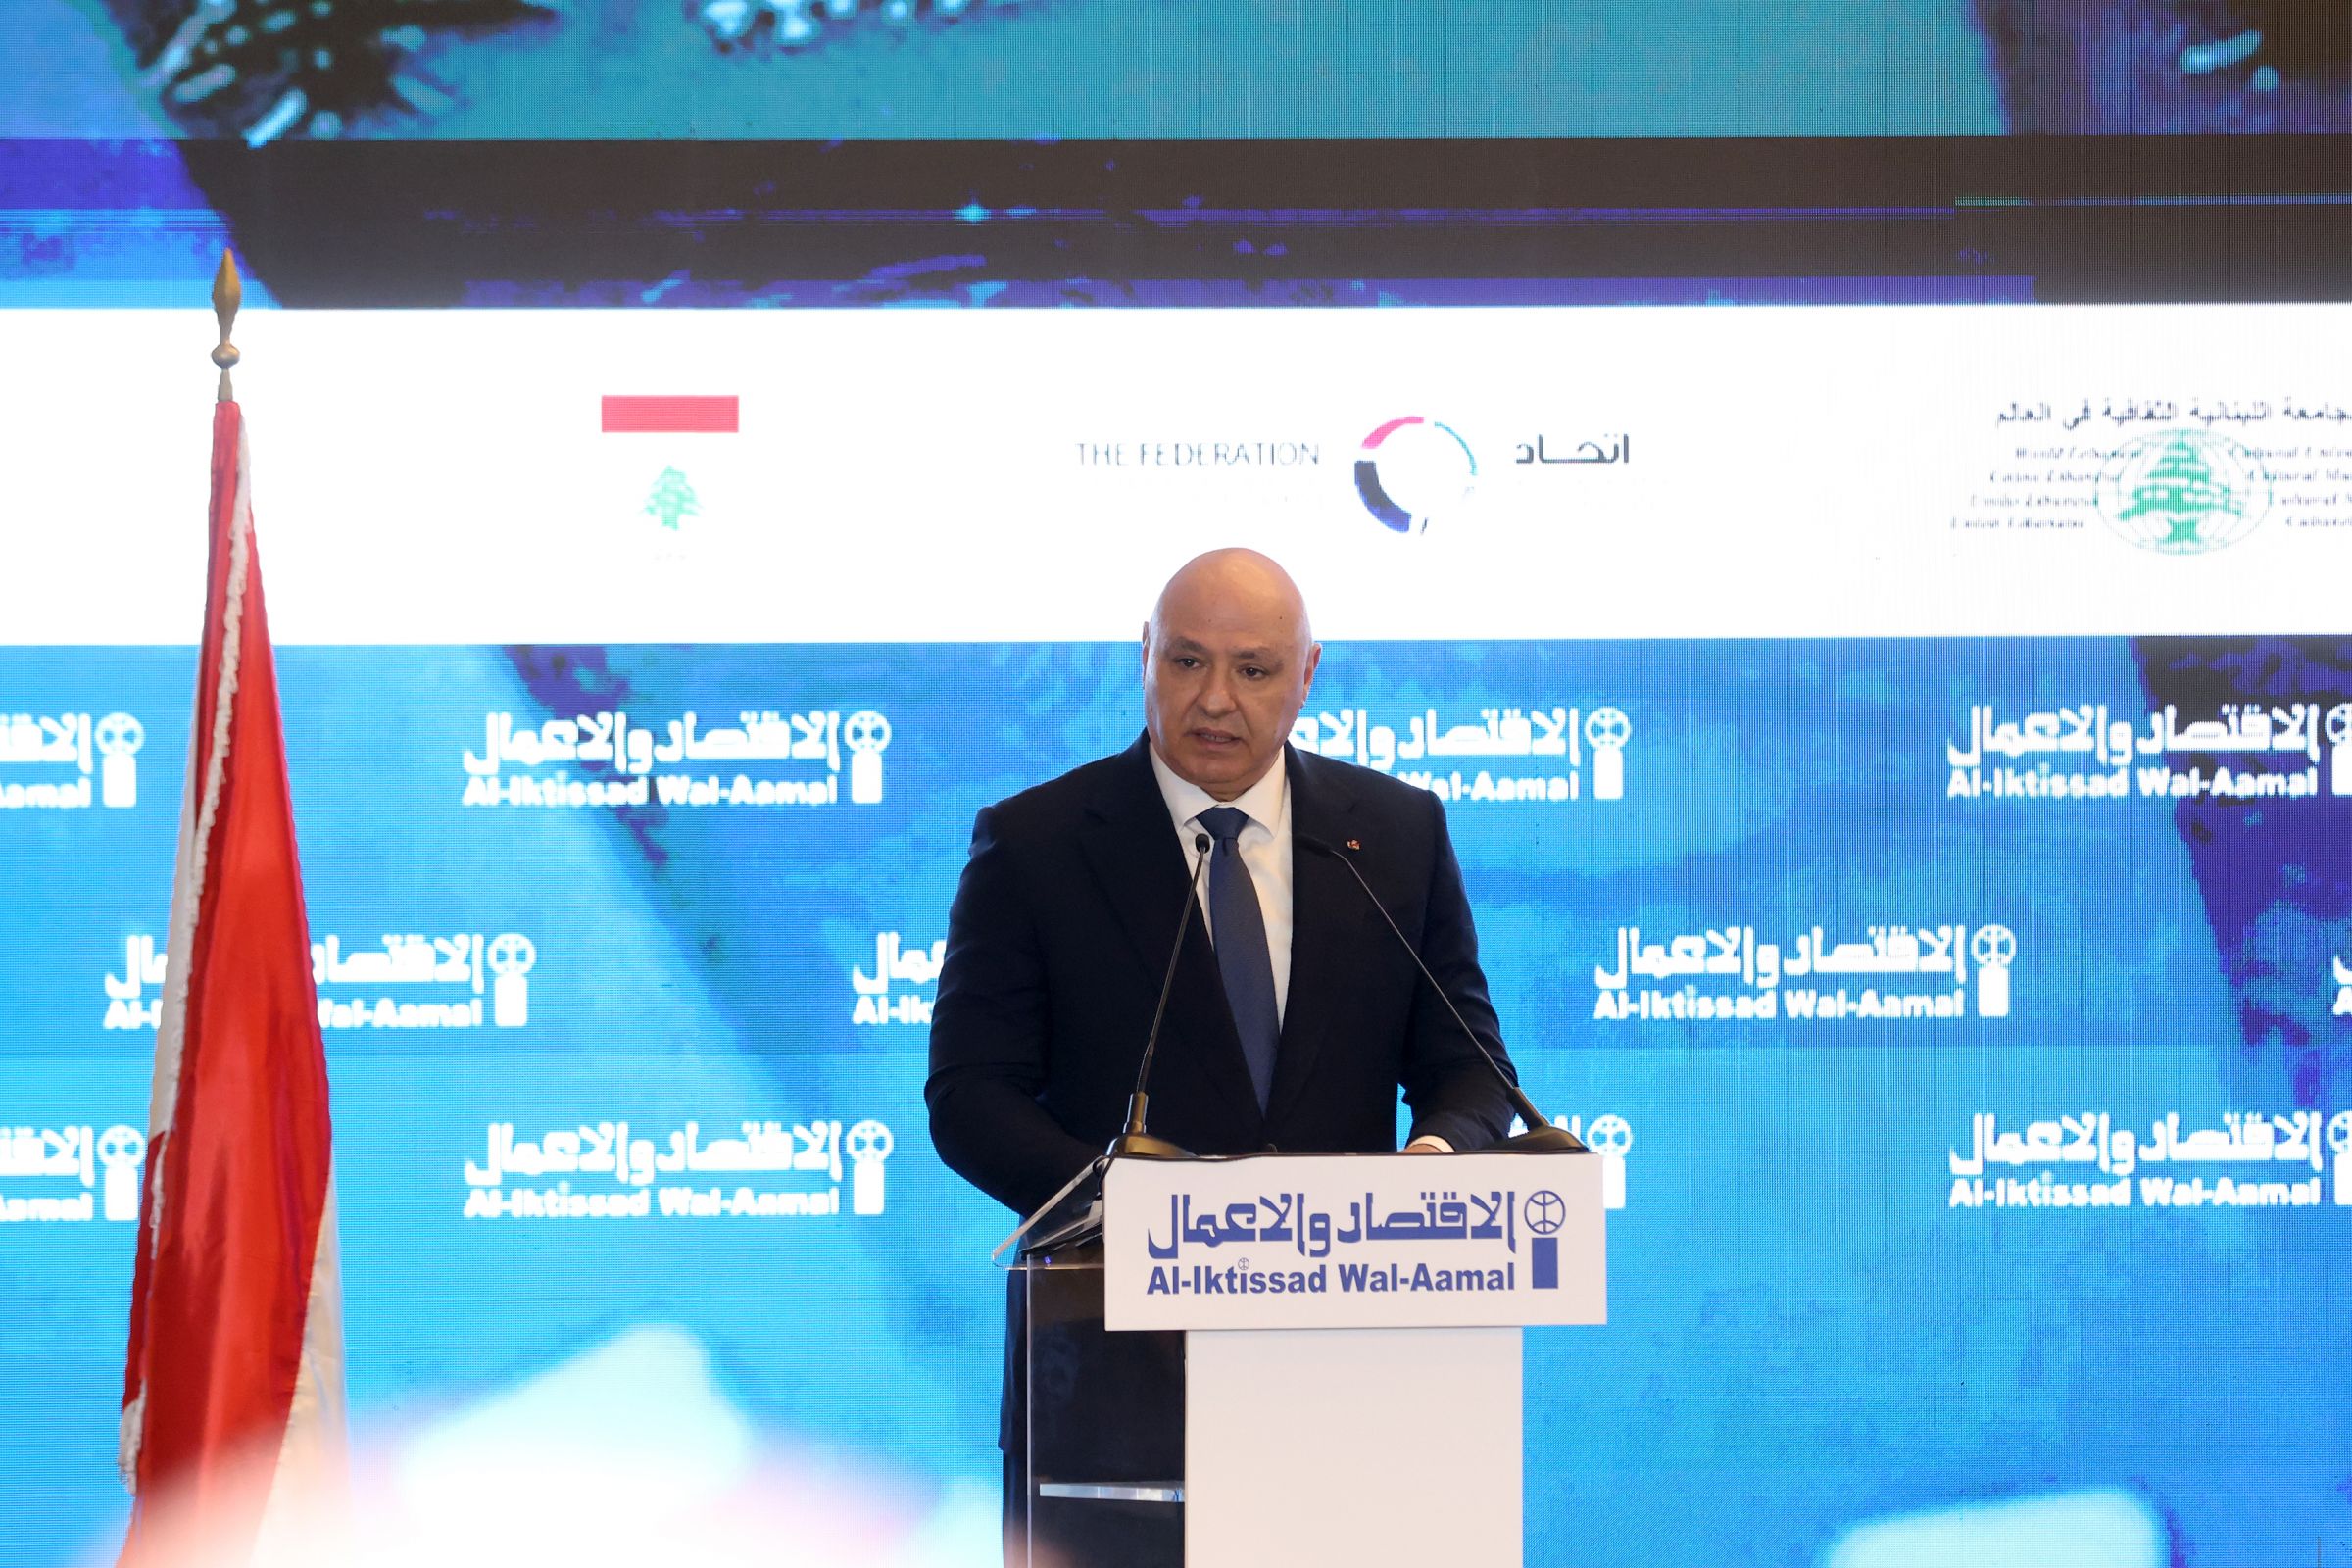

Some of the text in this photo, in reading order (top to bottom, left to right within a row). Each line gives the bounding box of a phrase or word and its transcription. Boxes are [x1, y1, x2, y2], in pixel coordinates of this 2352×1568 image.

[2062, 397, 2091, 431] في
[1075, 442, 1321, 466] THE FEDERATION
[1515, 433, 1631, 465] اتحاد
[463, 772, 838, 806] Al-Iktissad Wal-Aamal
[1946, 762, 2318, 798] Al-Iktissad Wal-Aamal
[1594, 985, 1964, 1019] Al-Iktissad Wal-Aamal
[464, 1183, 840, 1218] Al-Iktissad Wal-Aamal
[1948, 1172, 2321, 1207] Al-Iktissad Wal-Aamal
[1148, 1191, 1517, 1260] الاقتصاد والاعمال
[1147, 1258, 1516, 1296] Al-Iktissad Wal-Aamal
